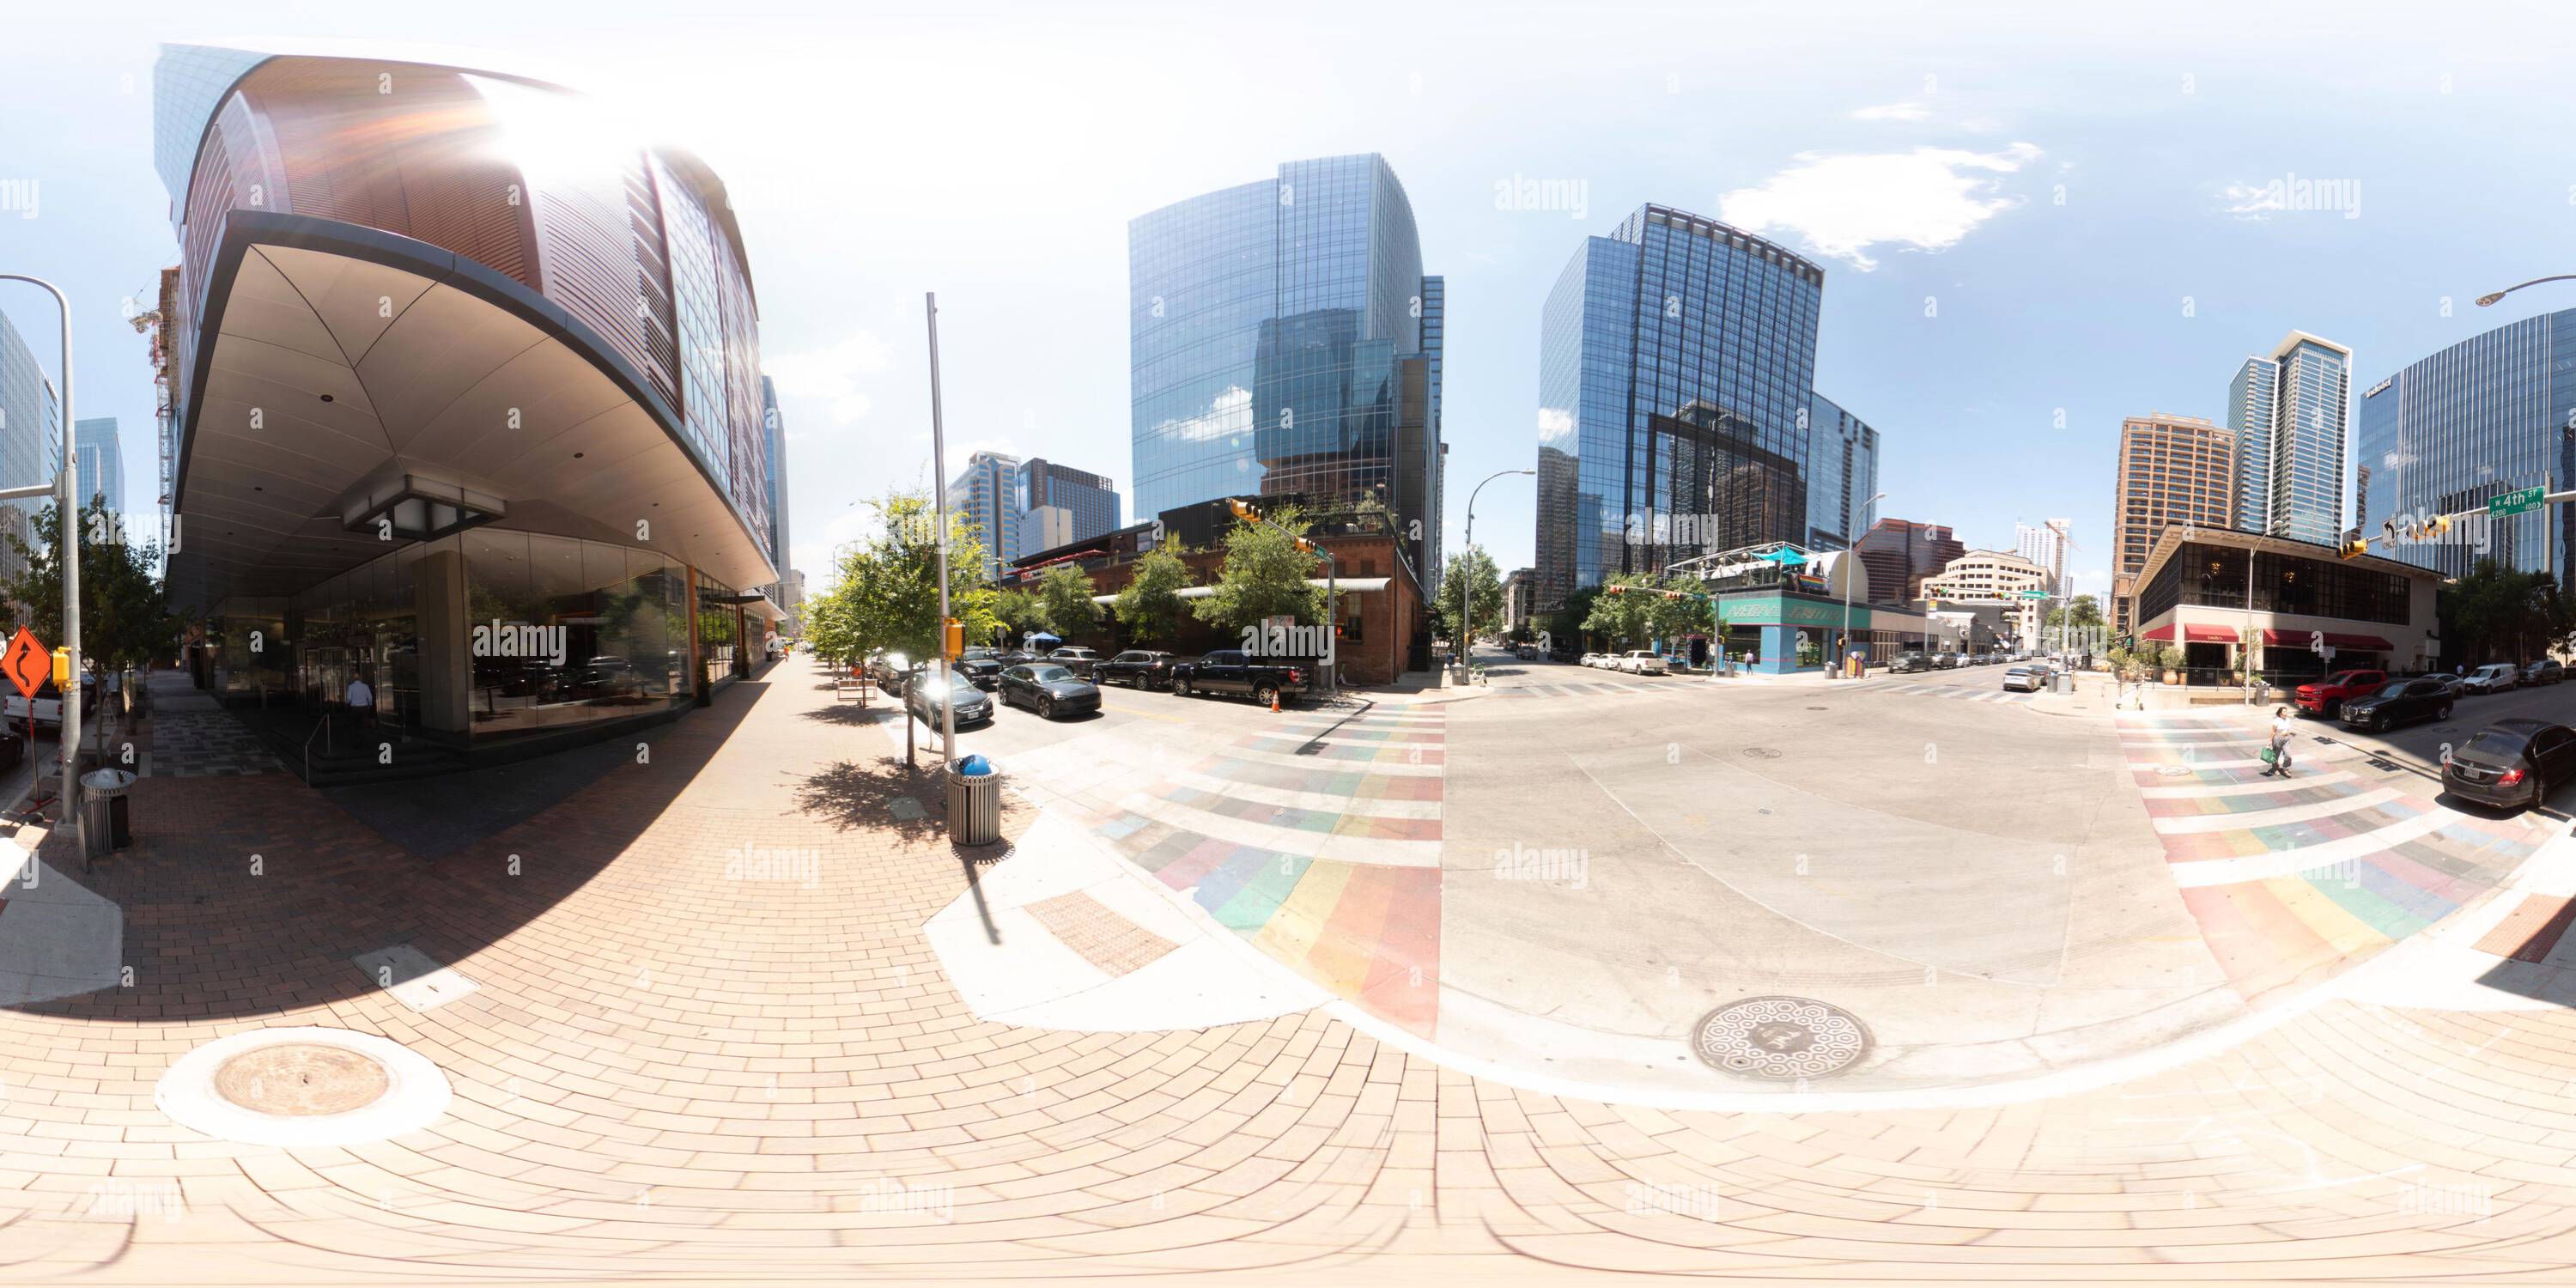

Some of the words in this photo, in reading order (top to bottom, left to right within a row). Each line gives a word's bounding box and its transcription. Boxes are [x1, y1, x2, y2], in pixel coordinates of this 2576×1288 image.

[2504, 493, 2524, 507] 4th
[2528, 489, 2537, 498] ST
[2383, 540, 2396, 550] ONLY
